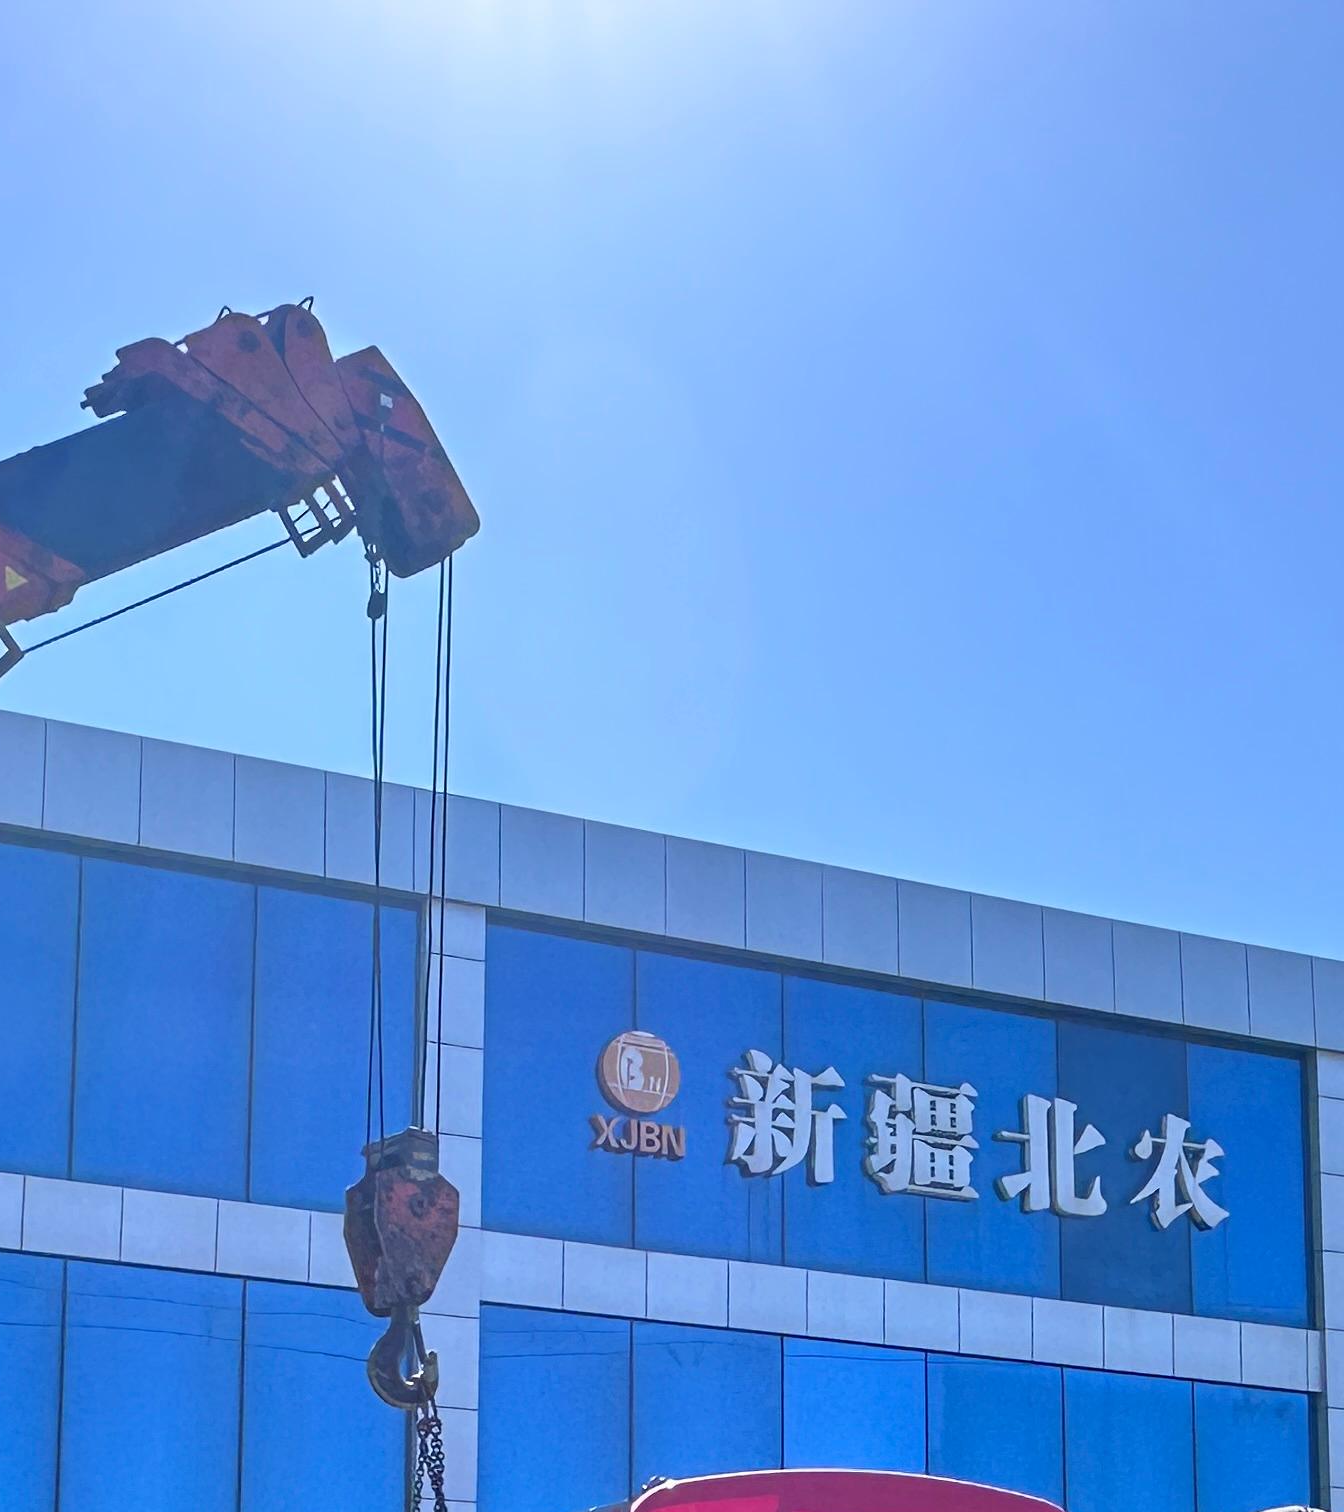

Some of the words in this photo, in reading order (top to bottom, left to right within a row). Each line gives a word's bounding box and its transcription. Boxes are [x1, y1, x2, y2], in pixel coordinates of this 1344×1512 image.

[591, 1113, 686, 1160] XJBN
[729, 1048, 1231, 1230] 新疆北农
